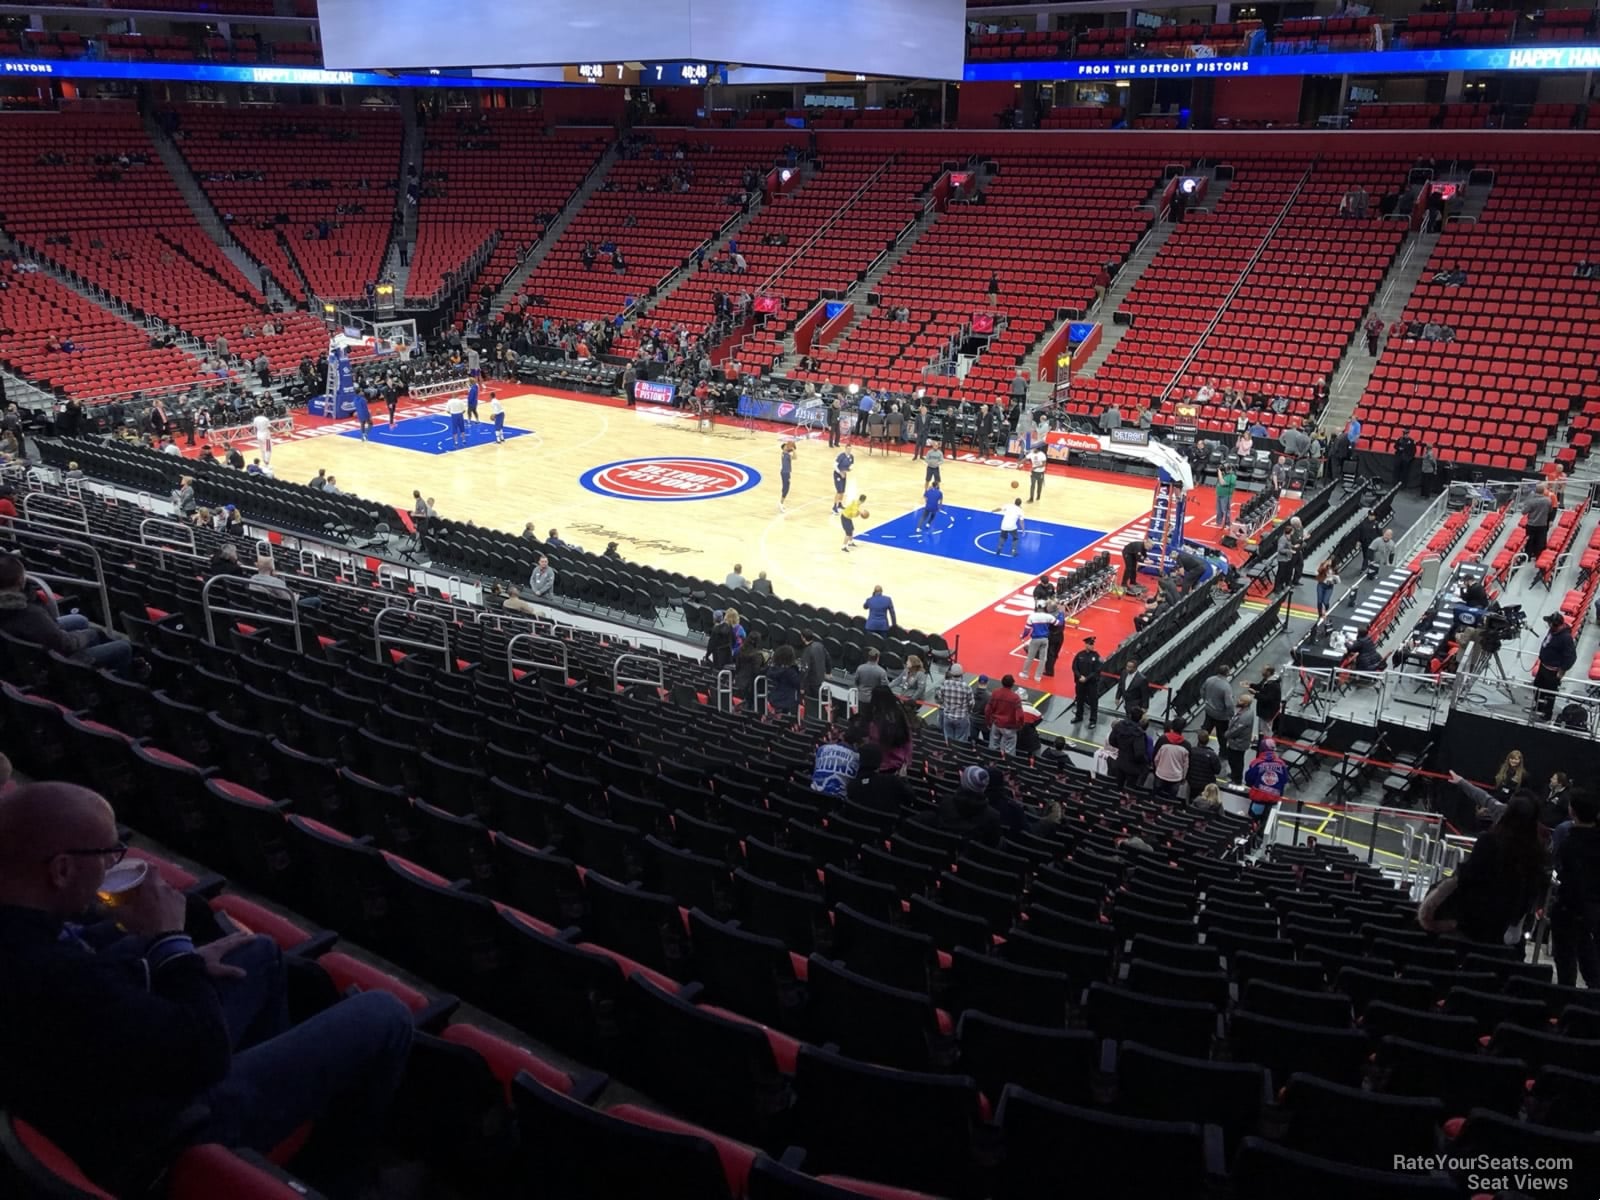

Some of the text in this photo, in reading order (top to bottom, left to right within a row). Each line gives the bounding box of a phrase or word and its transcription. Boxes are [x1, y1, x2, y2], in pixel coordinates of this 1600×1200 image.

[1508, 48, 1562, 69] HAPPY
[5, 63, 53, 73] PISTONS
[617, 65, 624, 79] 7
[655, 65, 707, 80] 7 40:48
[1079, 62, 1249, 74] FROM THE DETROIT PISTONS
[253, 69, 290, 82] HAPPY
[640, 391, 666, 402] PISTONS
[618, 470, 711, 492] PISTONS
[638, 464, 728, 486] DETROIT
